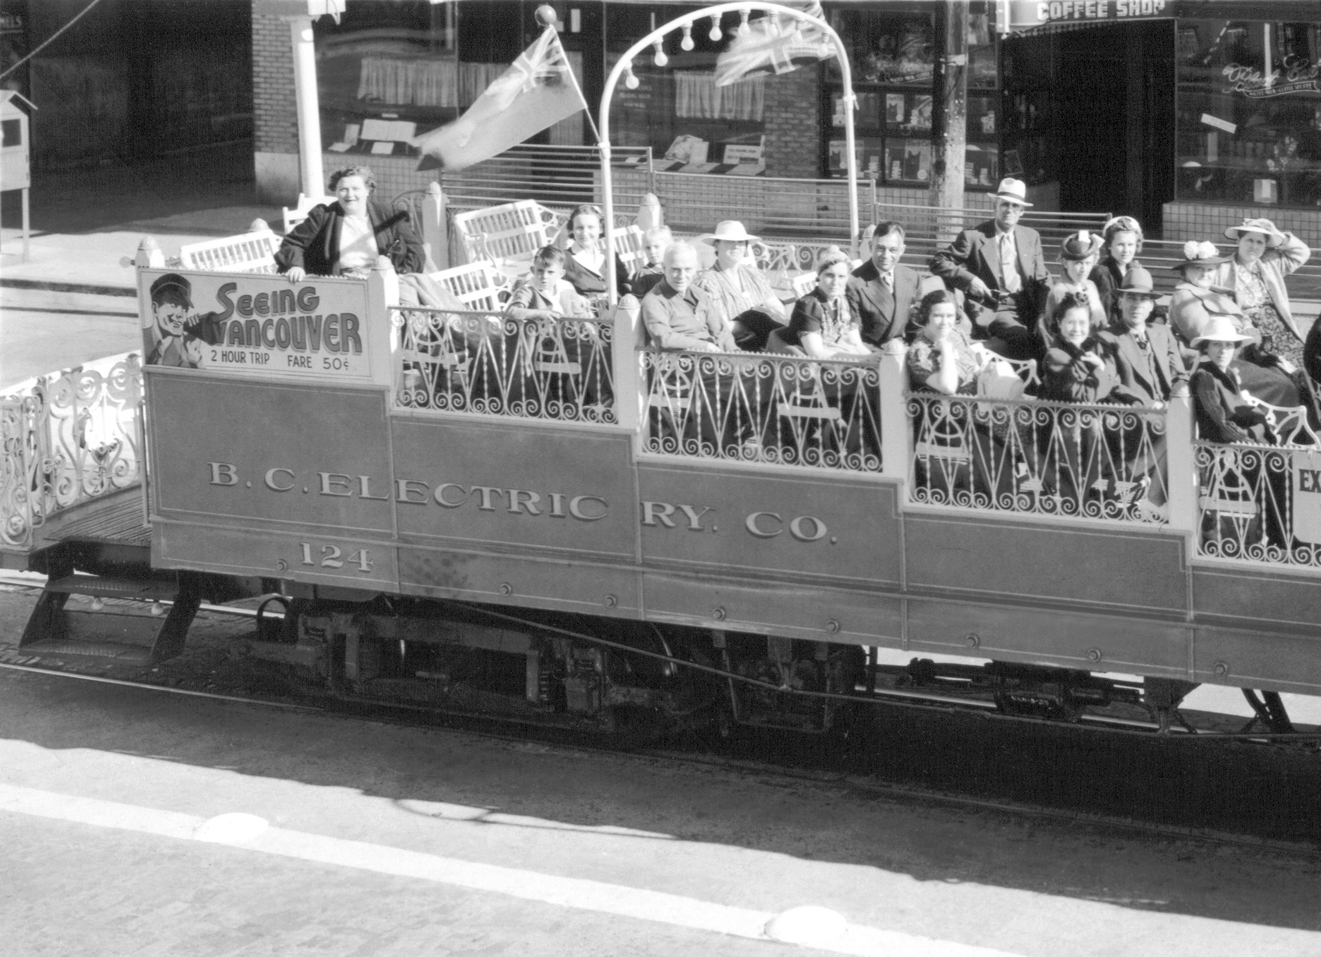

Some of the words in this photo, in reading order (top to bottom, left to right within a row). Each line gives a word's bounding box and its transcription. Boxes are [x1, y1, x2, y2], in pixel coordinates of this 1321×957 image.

[1037, 1, 1108, 21] COFFEE
[1116, 0, 1166, 17] SHOP
[210, 350, 218, 362] 2
[221, 350, 247, 364] HOUR
[249, 352, 270, 365] TRIP
[287, 355, 312, 368] FARE
[322, 357, 349, 371] 50¢
[640, 501, 718, 533] RY.
[745, 511, 838, 545] CO.
[300, 542, 374, 573] 124
